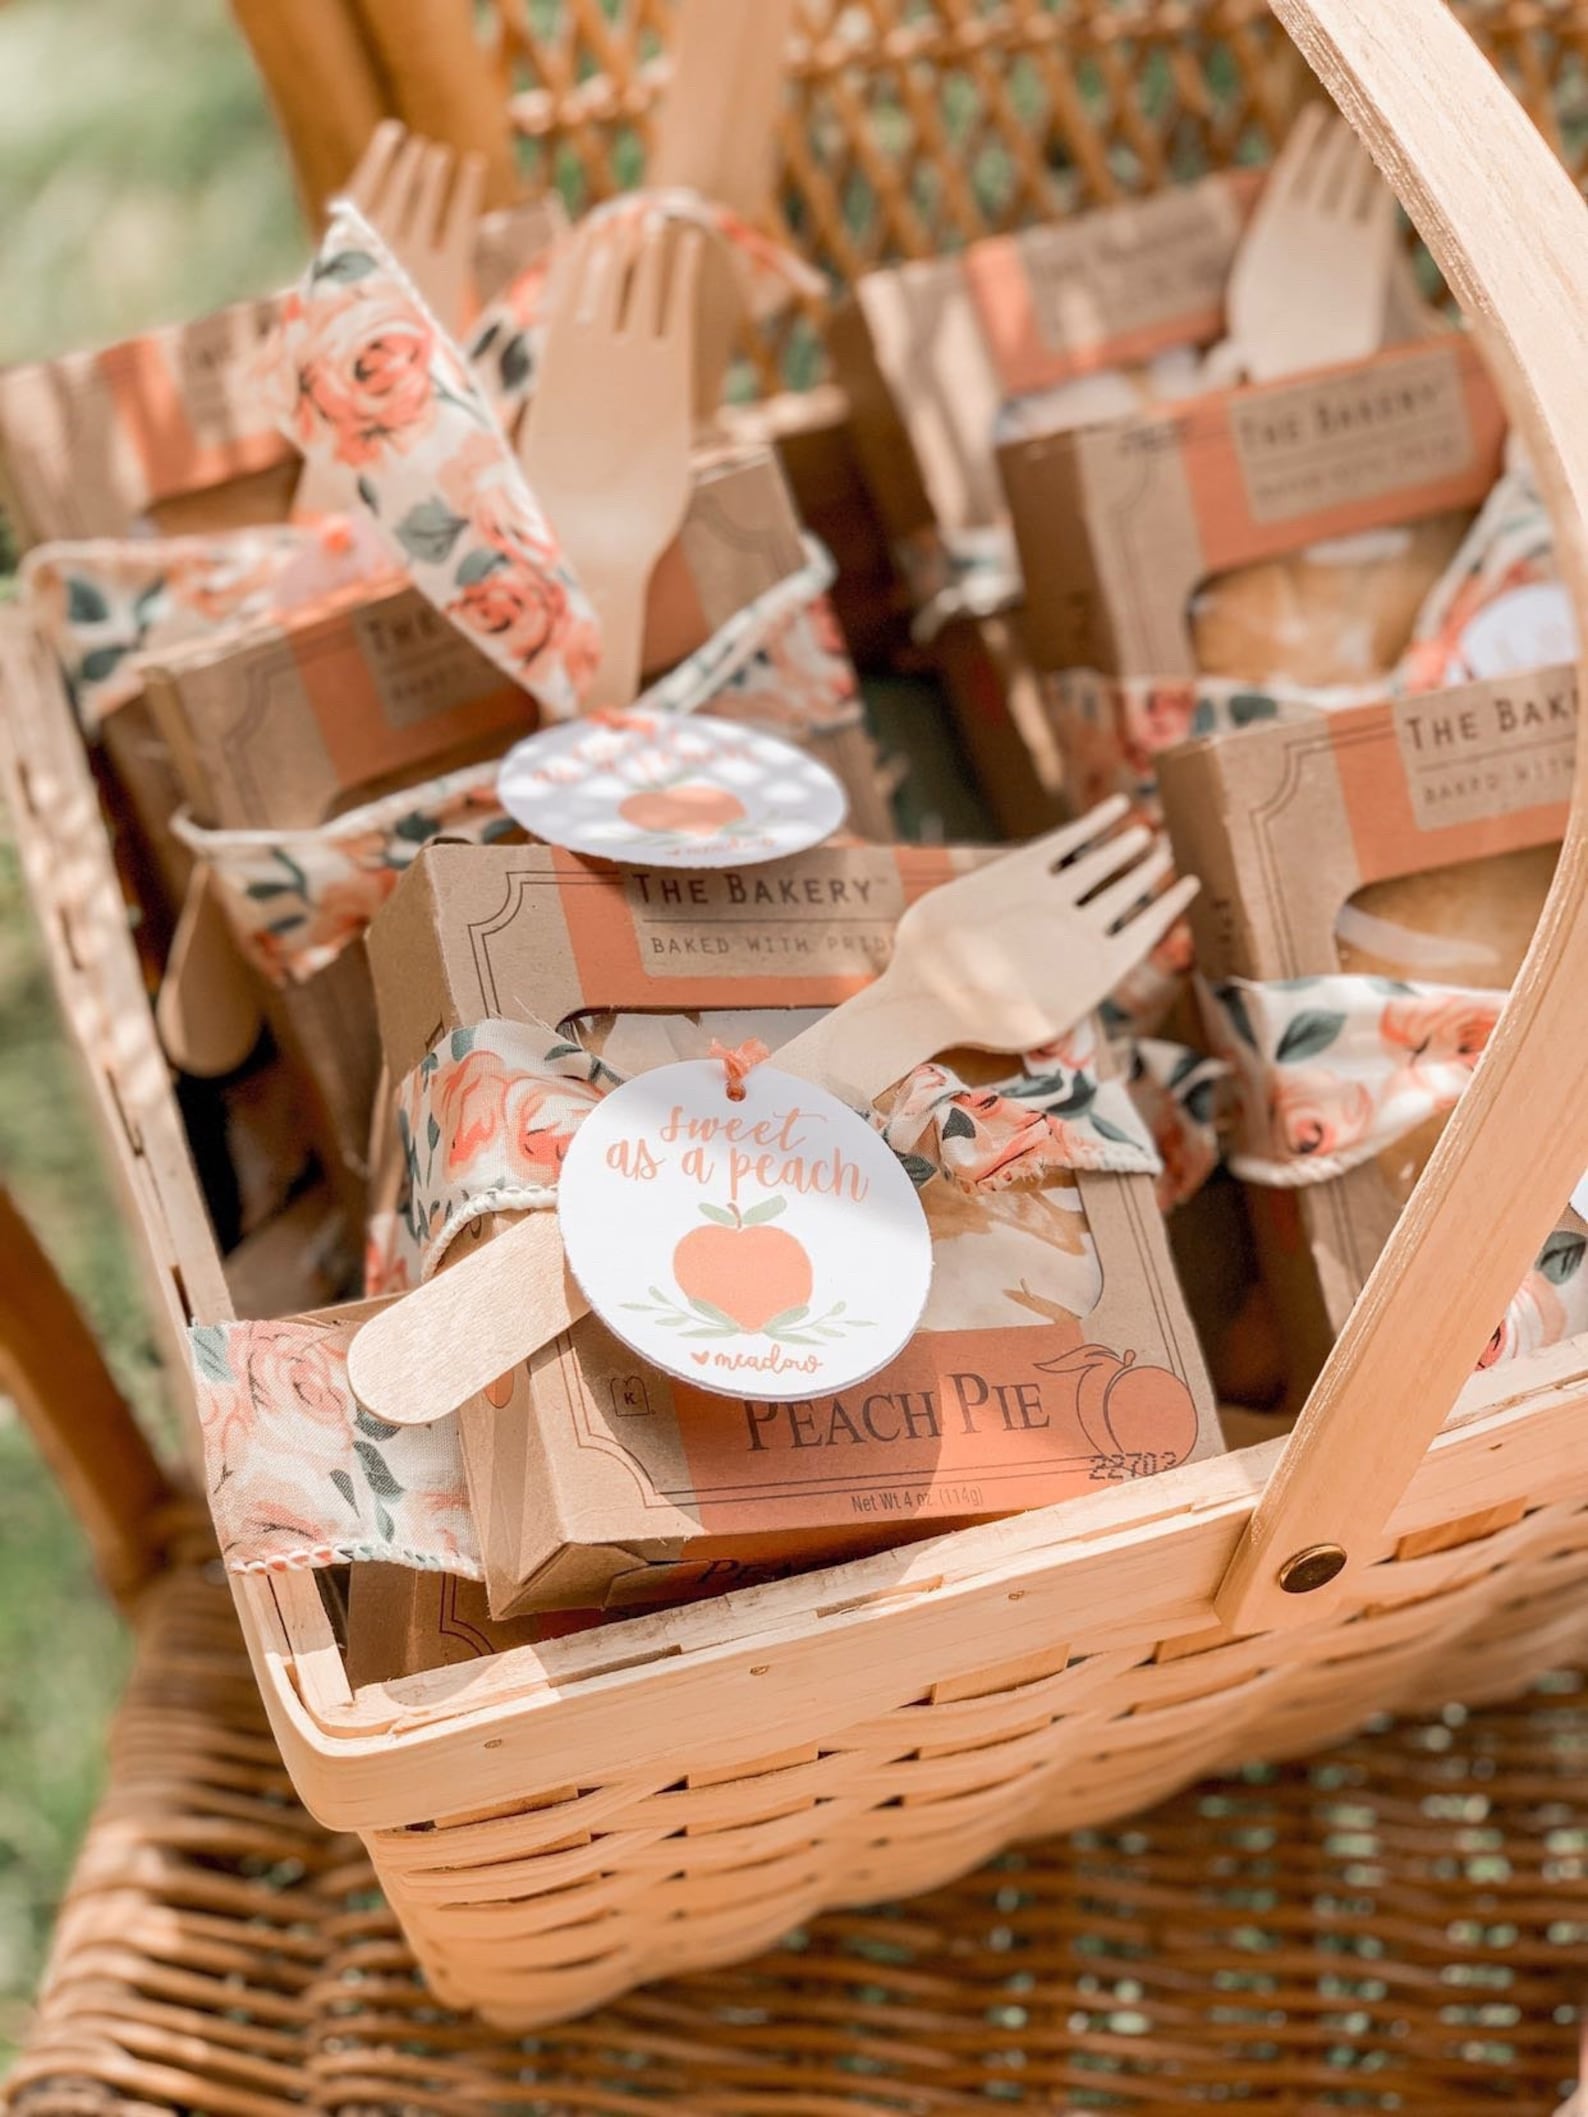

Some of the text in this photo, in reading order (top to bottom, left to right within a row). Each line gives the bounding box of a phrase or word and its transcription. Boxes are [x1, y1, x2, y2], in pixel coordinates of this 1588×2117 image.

[1406, 711, 1479, 751] THE
[632, 873, 710, 904] THE
[651, 936, 730, 954] BAKED
[748, 936, 809, 953] WITH
[660, 1106, 827, 1152] sweet
[606, 1139, 869, 1202] as a peach
[714, 1344, 823, 1374] meadow
[743, 1372, 1050, 1451] PEACH PIE
[851, 1495, 878, 1513] Net
[878, 1493, 901, 1511] Wt
[902, 1491, 913, 1508] 4
